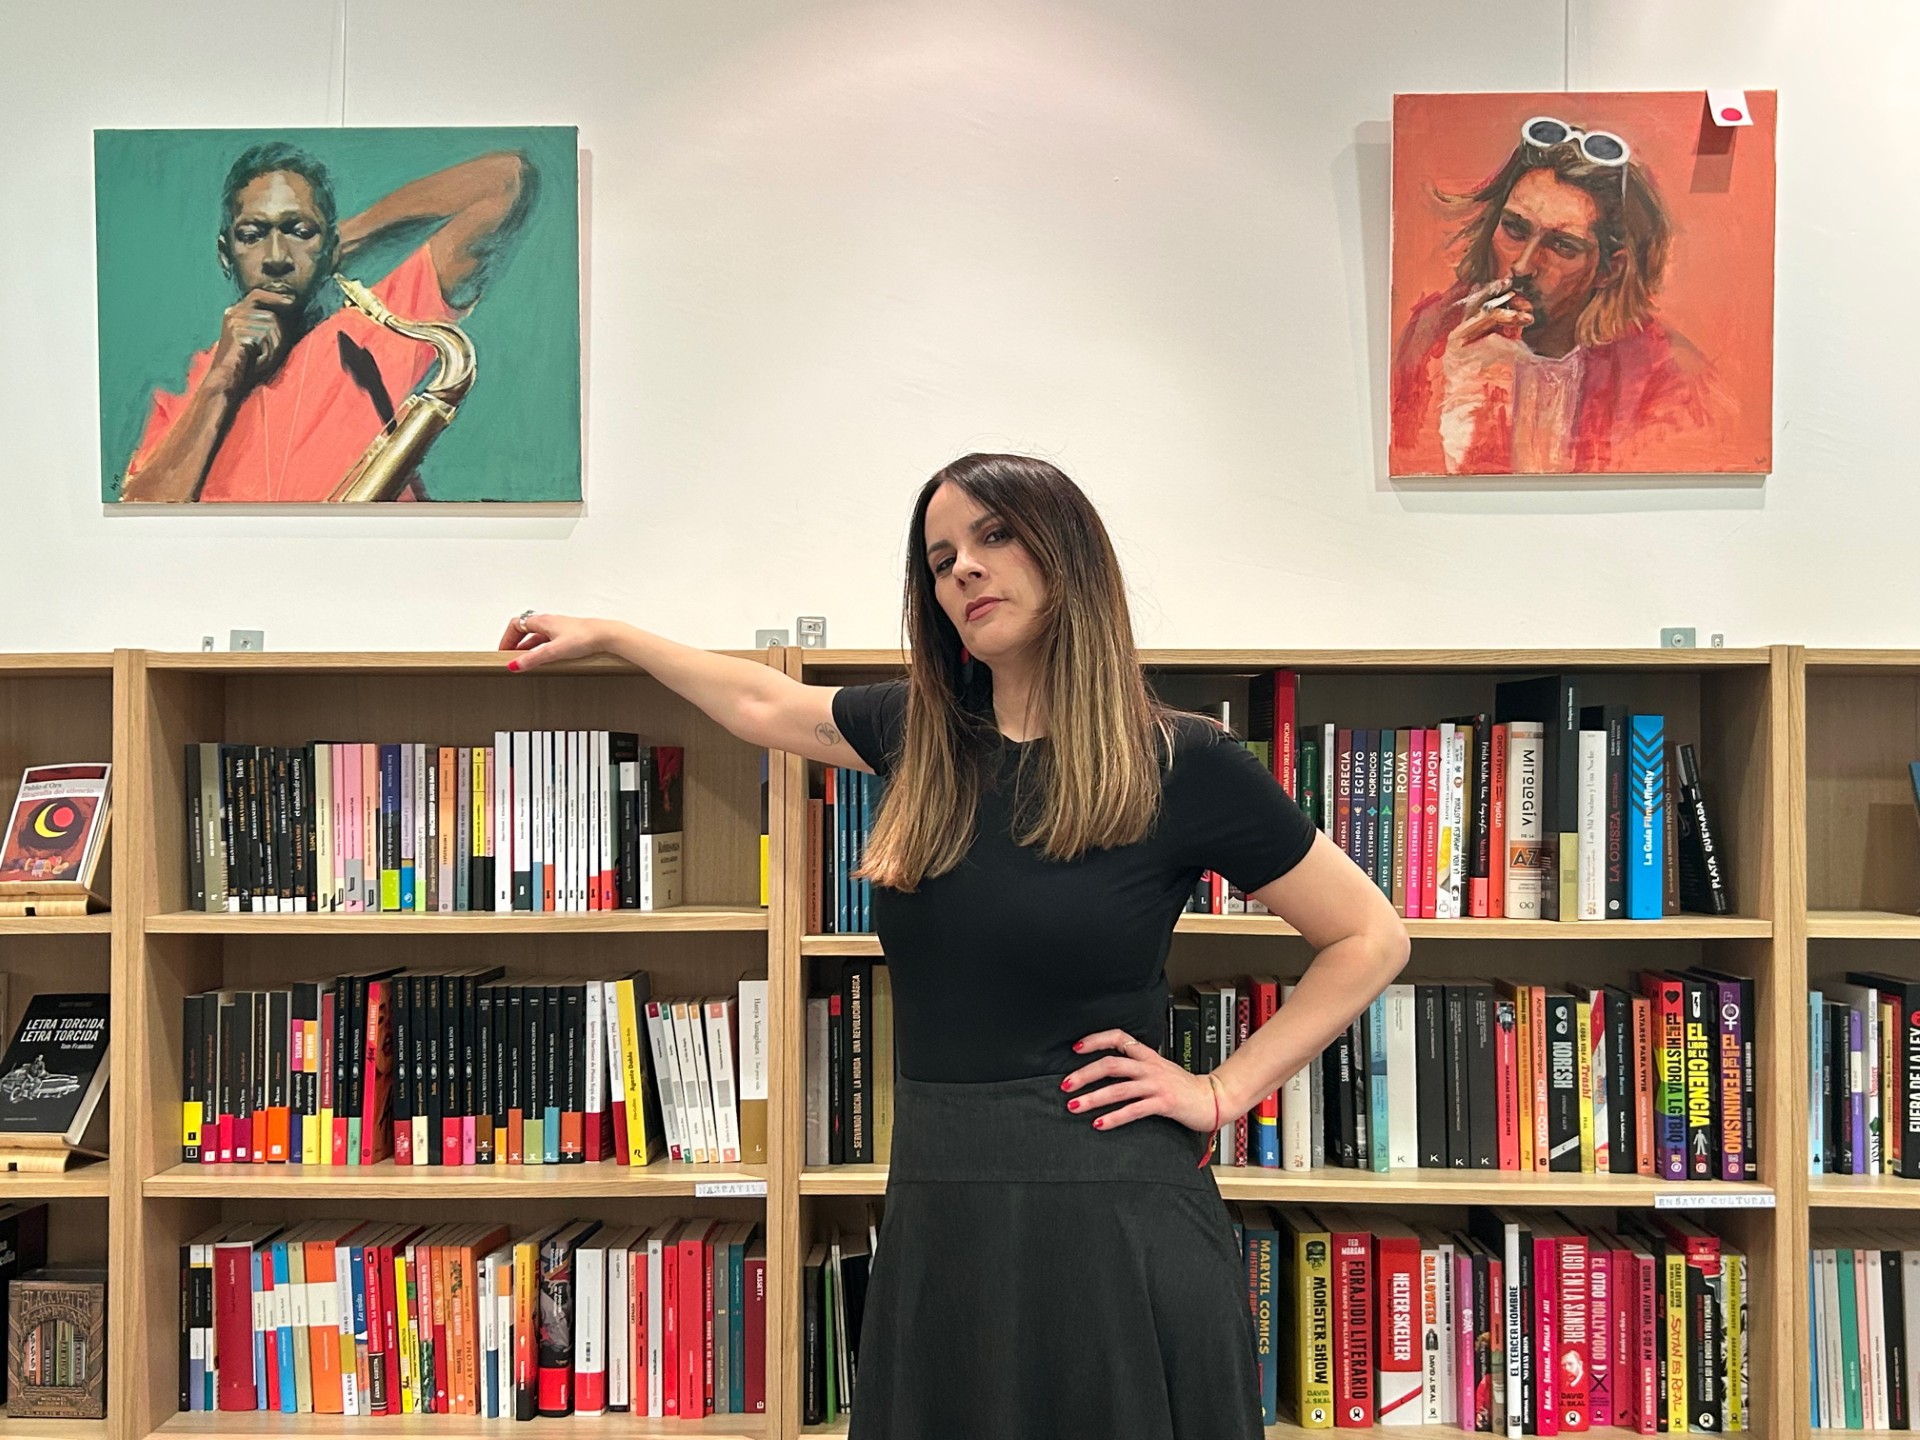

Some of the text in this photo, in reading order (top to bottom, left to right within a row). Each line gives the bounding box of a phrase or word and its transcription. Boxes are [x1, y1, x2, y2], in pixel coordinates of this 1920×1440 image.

[1340, 752, 1350, 795] GRECIA
[1354, 752, 1364, 794] EGIPTO
[1383, 752, 1393, 793] CELTAS
[1397, 752, 1408, 793] ROMA
[1412, 751, 1422, 788] INCAS
[1426, 752, 1438, 792] JAPÓN
[1494, 802, 1502, 829] UTOPÍA
[1644, 770, 1654, 865] La Guía FilmAffinity
[1609, 812, 1620, 882] LA ODISEA
[1696, 801, 1722, 888] PLATA QUEMADA
[25, 1019, 57, 1030] LETRA
[753, 998, 761, 1054] Hanya Yanagihara
[851, 975, 861, 1053] UNA REVOLUCIÓN MÁGICA
[1666, 1013, 1680, 1025] EL
[1687, 1023, 1708, 1041] EL
[20, 1030, 99, 1042] LETRA TORCIDA
[1537, 1019, 1545, 1074] González-Campos
[1688, 1050, 1708, 1058] DE LA
[1722, 1034, 1740, 1049] EL
[628, 1071, 636, 1091] Agente
[852, 1058, 861, 1088] LA HORDA
[1553, 1041, 1572, 1088] KORESH
[1581, 1065, 1591, 1099] Trash!
[1909, 1075, 1920, 1089] DE
[1537, 1079, 1546, 1147] CINE COSAS
[1688, 1059, 1710, 1127] CIENCIA
[1724, 1069, 1741, 1153] FEMINISMO
[1909, 1090, 1920, 1132] FUERA
[853, 1092, 862, 1148] SERVANDO ROCHA
[698, 1184, 766, 1194] NARRATIVA
[1659, 1196, 1774, 1206] ENSAYO CULTURAL
[1250, 1240, 1257, 1248] LA
[21, 1290, 91, 1316] BLACKWATER
[1259, 1240, 1270, 1354] MARVEL COMICS
[1424, 1256, 1436, 1324] HALLOWEEN
[1563, 1244, 1585, 1344] ALGO EN LA SANGRE
[1592, 1258, 1606, 1360] EL OTRO HOLLYWOOD
[1704, 1295, 1713, 1315] SINFONÍA
[357, 1313, 364, 1321] La
[1314, 1276, 1328, 1384] MONSTER SHOW
[1349, 1261, 1368, 1399] FORAJIDO LITERARIO
[1393, 1273, 1410, 1360] HELTER SKELTER
[1510, 1286, 1519, 1376] EL TERCER HOMBRE
[1704, 1316, 1712, 1331] PARA
[706, 1350, 711, 1360] EN
[1672, 1360, 1682, 1374] ES
[1704, 1340, 1712, 1359] CIUDAD
[1672, 1378, 1683, 1411] REAL
[1705, 1378, 1713, 1401] MUERTOS
